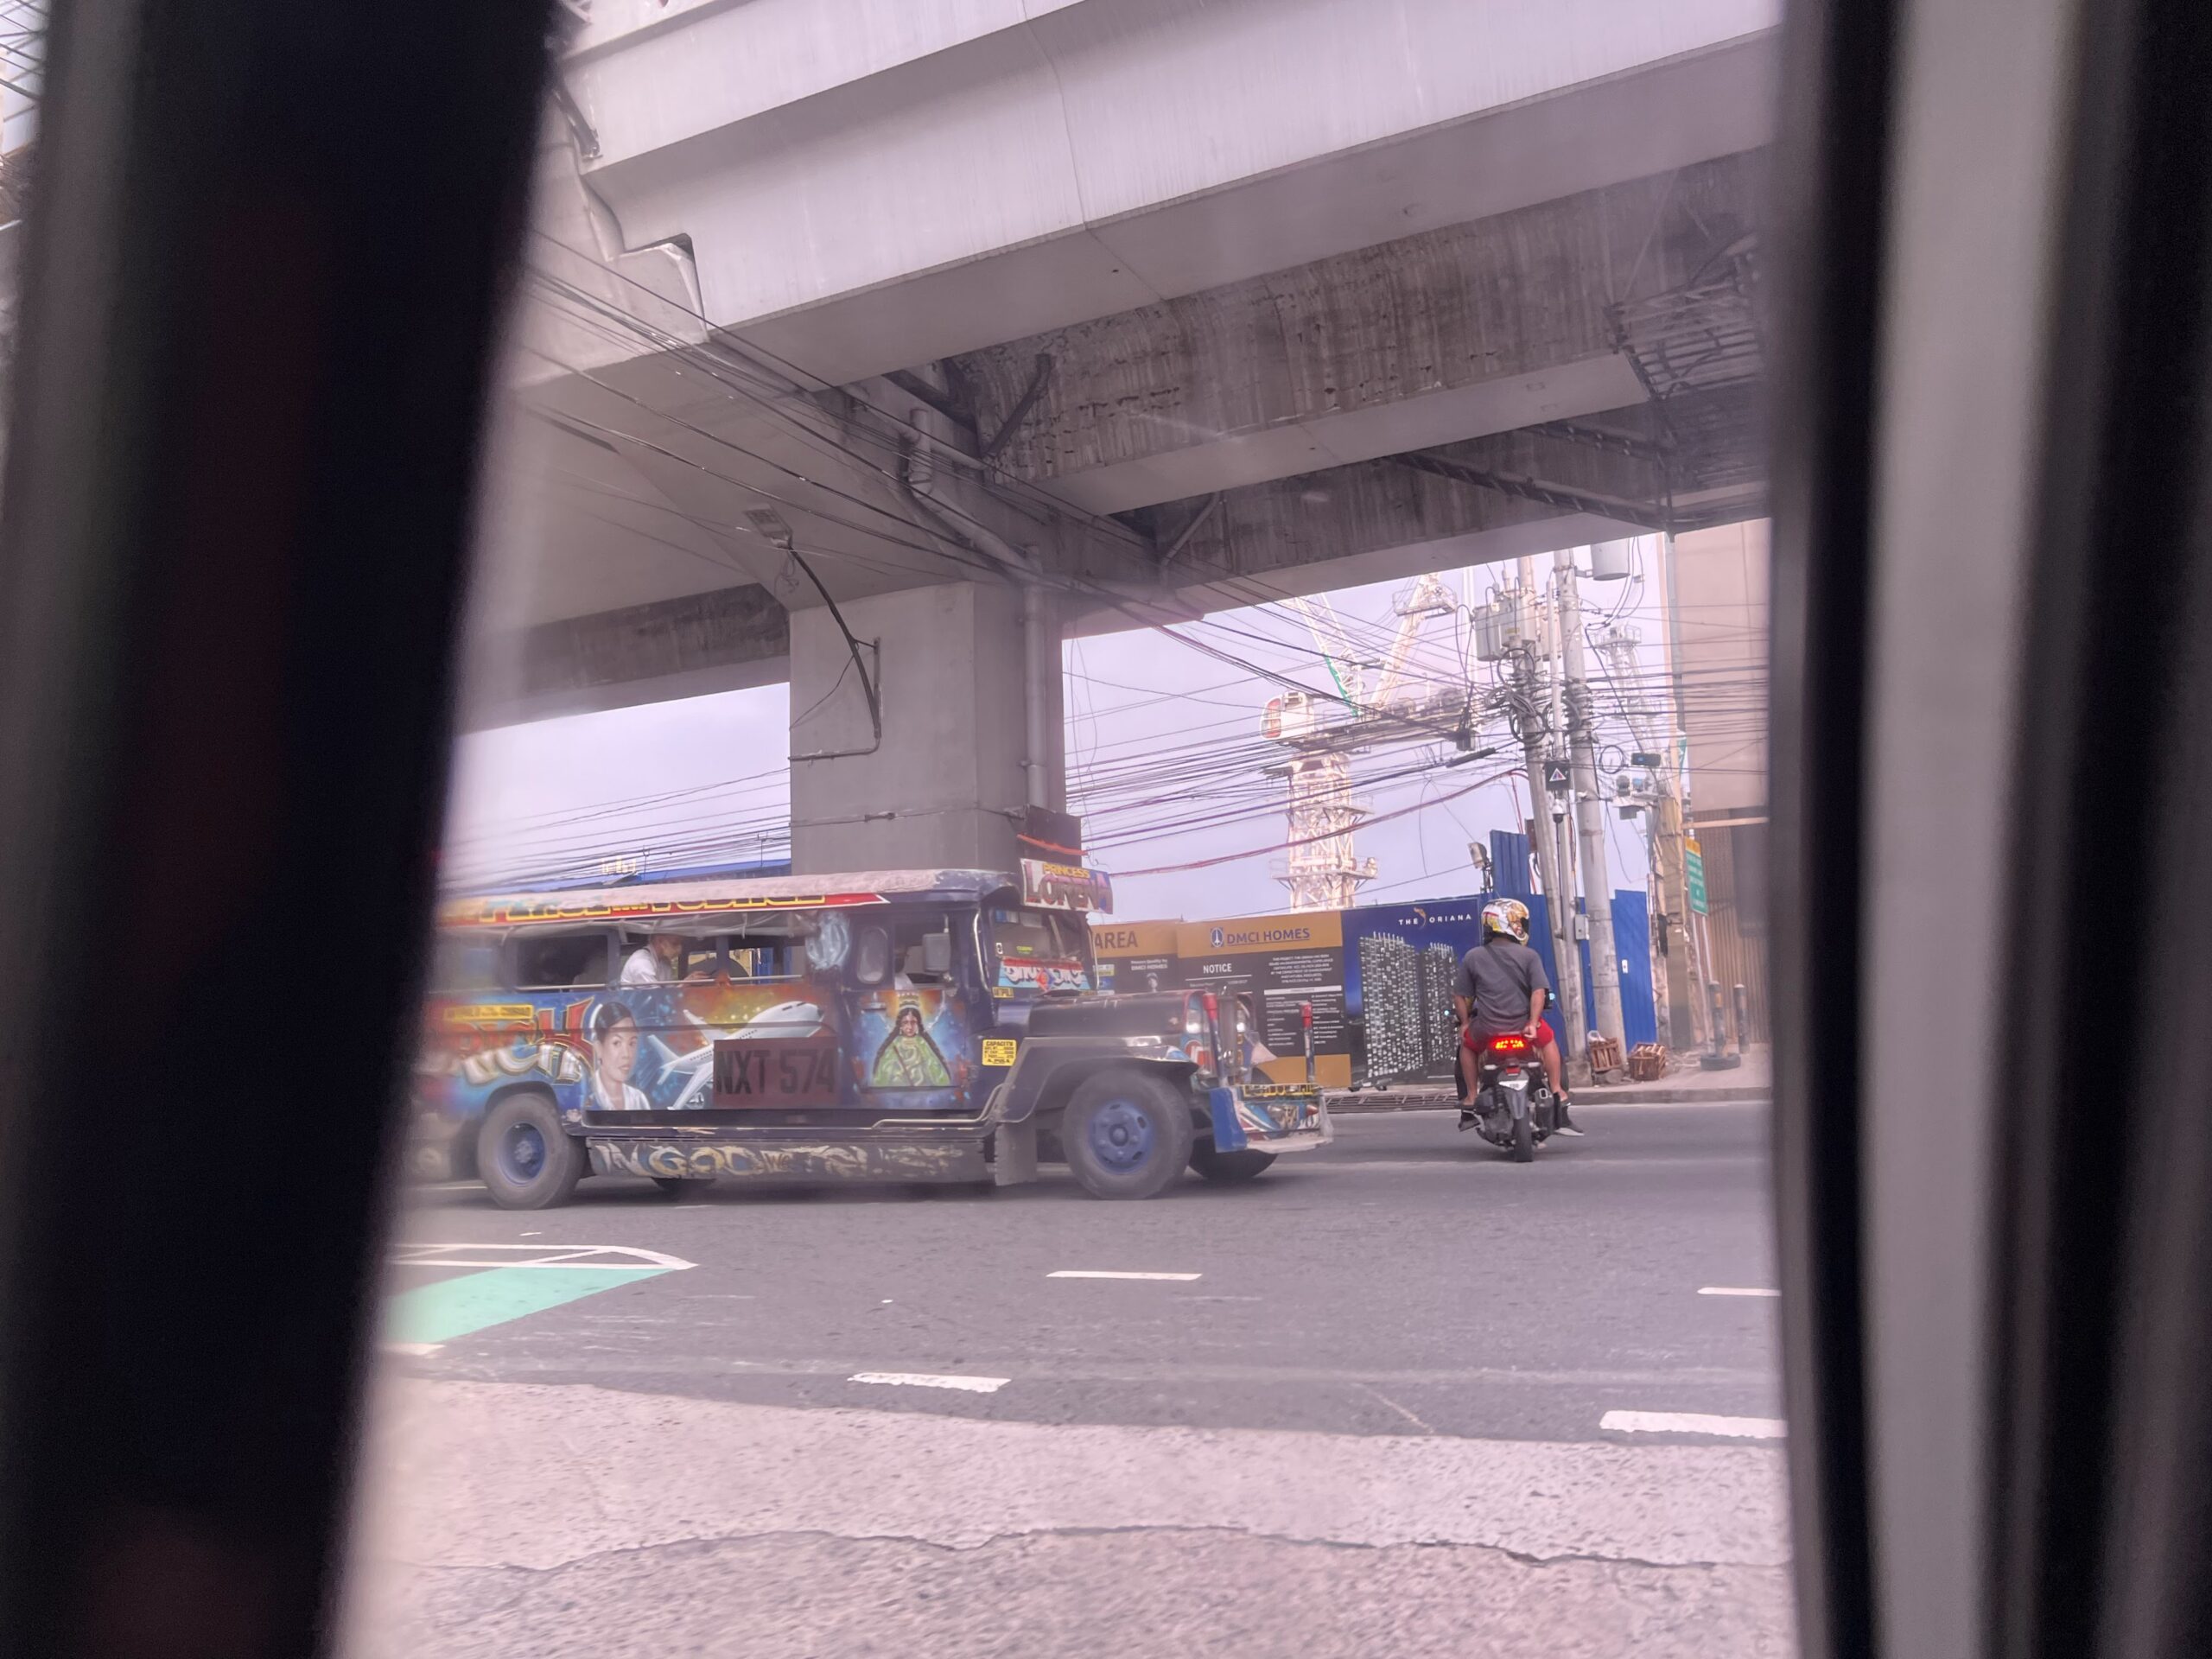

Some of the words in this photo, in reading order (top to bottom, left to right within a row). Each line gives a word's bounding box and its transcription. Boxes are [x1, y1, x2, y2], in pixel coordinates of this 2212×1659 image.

[1043, 863, 1090, 879] PRINCESS
[1024, 861, 1113, 914] LORENA
[1429, 914, 1471, 924] ORIANA
[1094, 931, 1139, 950] AREA
[1227, 931, 1260, 944] DMCI
[1263, 927, 1311, 942] HOMES
[1203, 963, 1232, 974] NOTICE
[715, 1049, 771, 1095] NXT
[779, 1047, 836, 1094] 574
